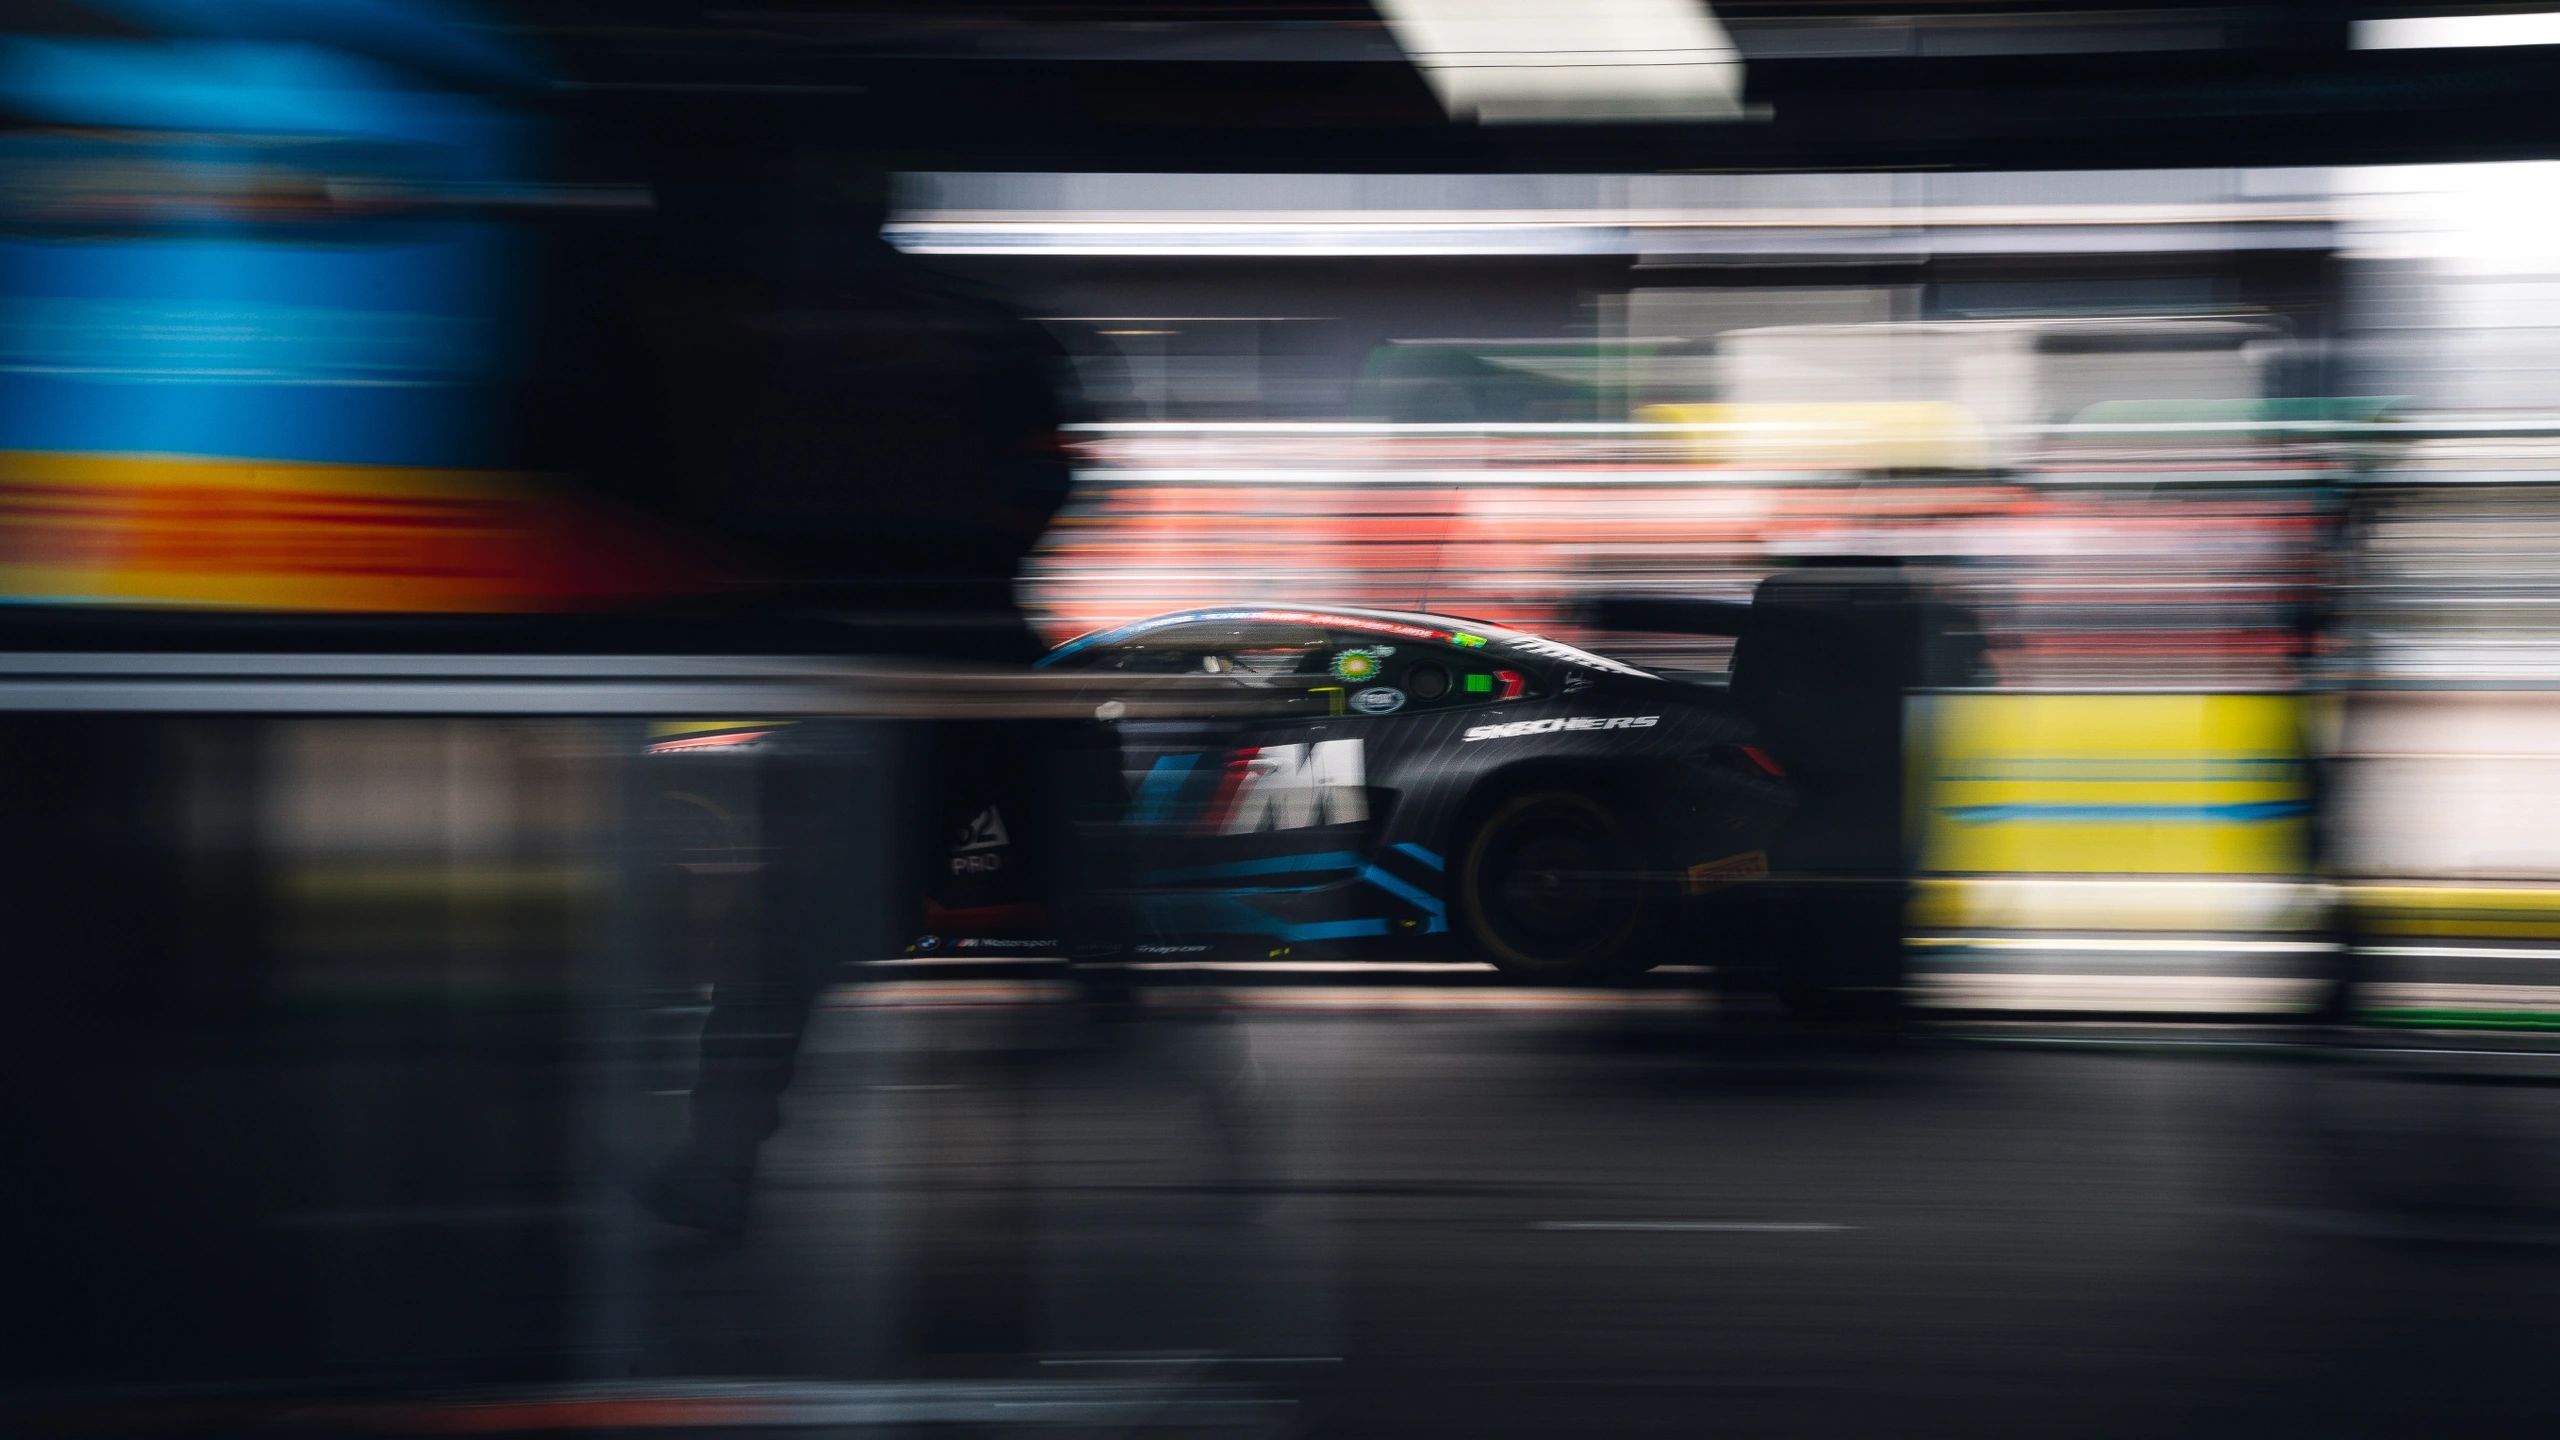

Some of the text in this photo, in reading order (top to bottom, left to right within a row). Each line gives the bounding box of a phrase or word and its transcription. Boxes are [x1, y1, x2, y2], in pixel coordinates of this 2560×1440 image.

[1462, 716, 1660, 742] SKECHERS
[1216, 738, 1370, 836] M
[951, 852, 1001, 876] PRO
[981, 937, 1058, 949] Motorsport
